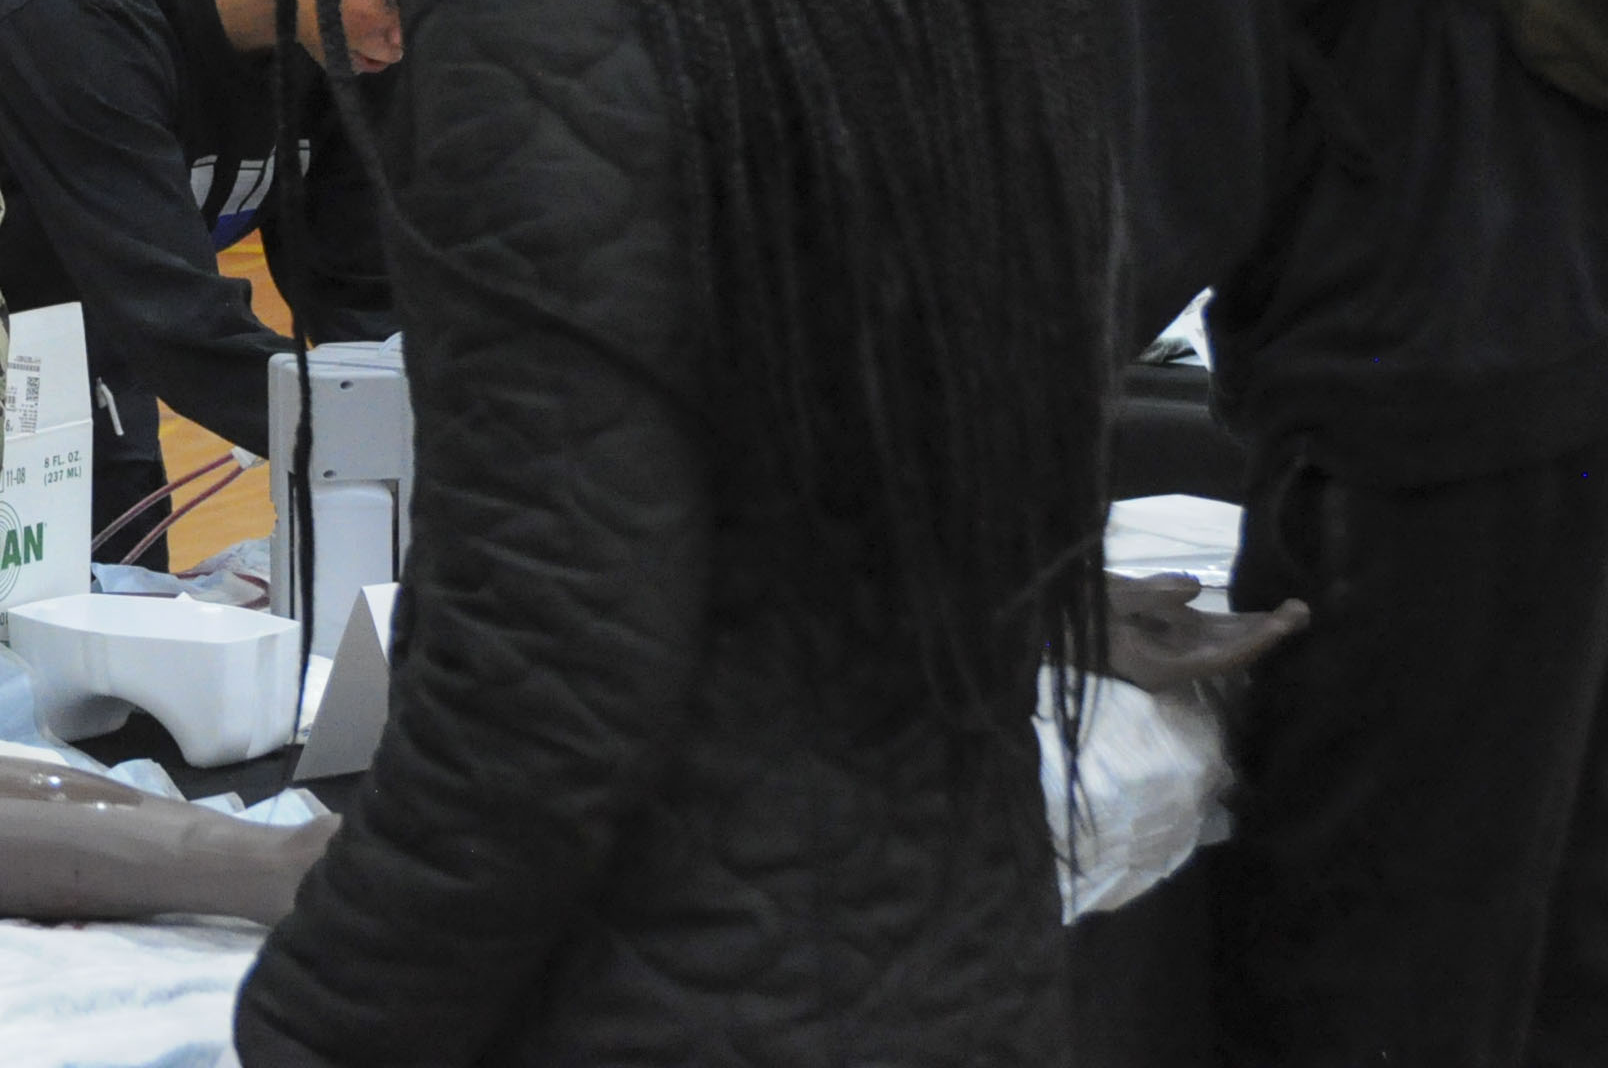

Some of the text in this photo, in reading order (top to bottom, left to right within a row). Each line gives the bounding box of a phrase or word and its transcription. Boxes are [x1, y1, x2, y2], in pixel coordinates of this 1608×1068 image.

[44, 457, 50, 468] 8
[6, 467, 26, 487] 11-08
[44, 466, 82, 486] (237 ML)
